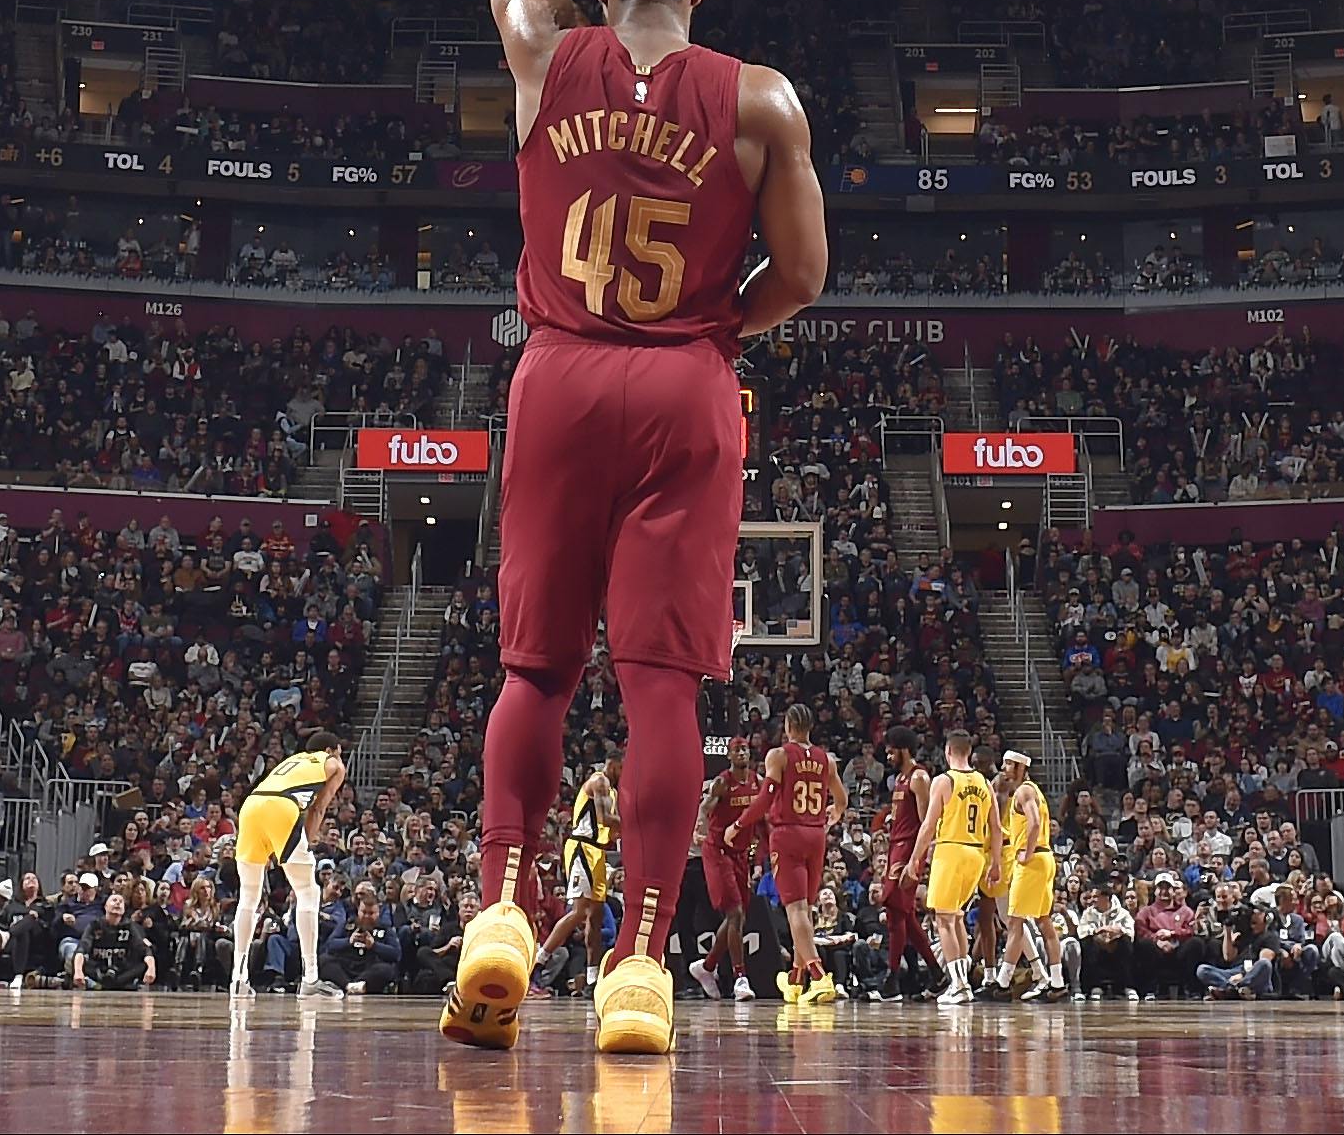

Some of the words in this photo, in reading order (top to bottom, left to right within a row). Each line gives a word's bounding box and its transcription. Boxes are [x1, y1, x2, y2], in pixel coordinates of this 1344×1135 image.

[70, 25, 93, 37] 230
[142, 31, 163, 42] 231
[1274, 37, 1295, 49] 202
[439, 45, 460, 56] 231
[905, 47, 926, 58] 201
[974, 48, 996, 59] 202
[546, 109, 719, 188] MITCHELL
[104, 152, 145, 171] TOL
[158, 155, 173, 174] 4
[207, 159, 273, 179] FOULS
[287, 163, 300, 182] 5
[332, 166, 378, 183] FG%
[391, 164, 417, 185] 57
[917, 168, 949, 191] 85
[1009, 172, 1055, 189] FG%
[1066, 171, 1093, 191] 53
[1131, 168, 1197, 188] FOULS
[1214, 165, 1227, 184] 3
[1263, 162, 1304, 180] TOL
[1319, 159, 1332, 178] 3
[560, 189, 692, 323] 45
[145, 302, 182, 317] M126
[1247, 309, 1285, 324] M102
[388, 434, 458, 465] fubo
[973, 437, 1044, 468] fubo
[705, 736, 731, 746] SEAT
[792, 780, 824, 815] 35
[968, 803, 978, 835] 9
